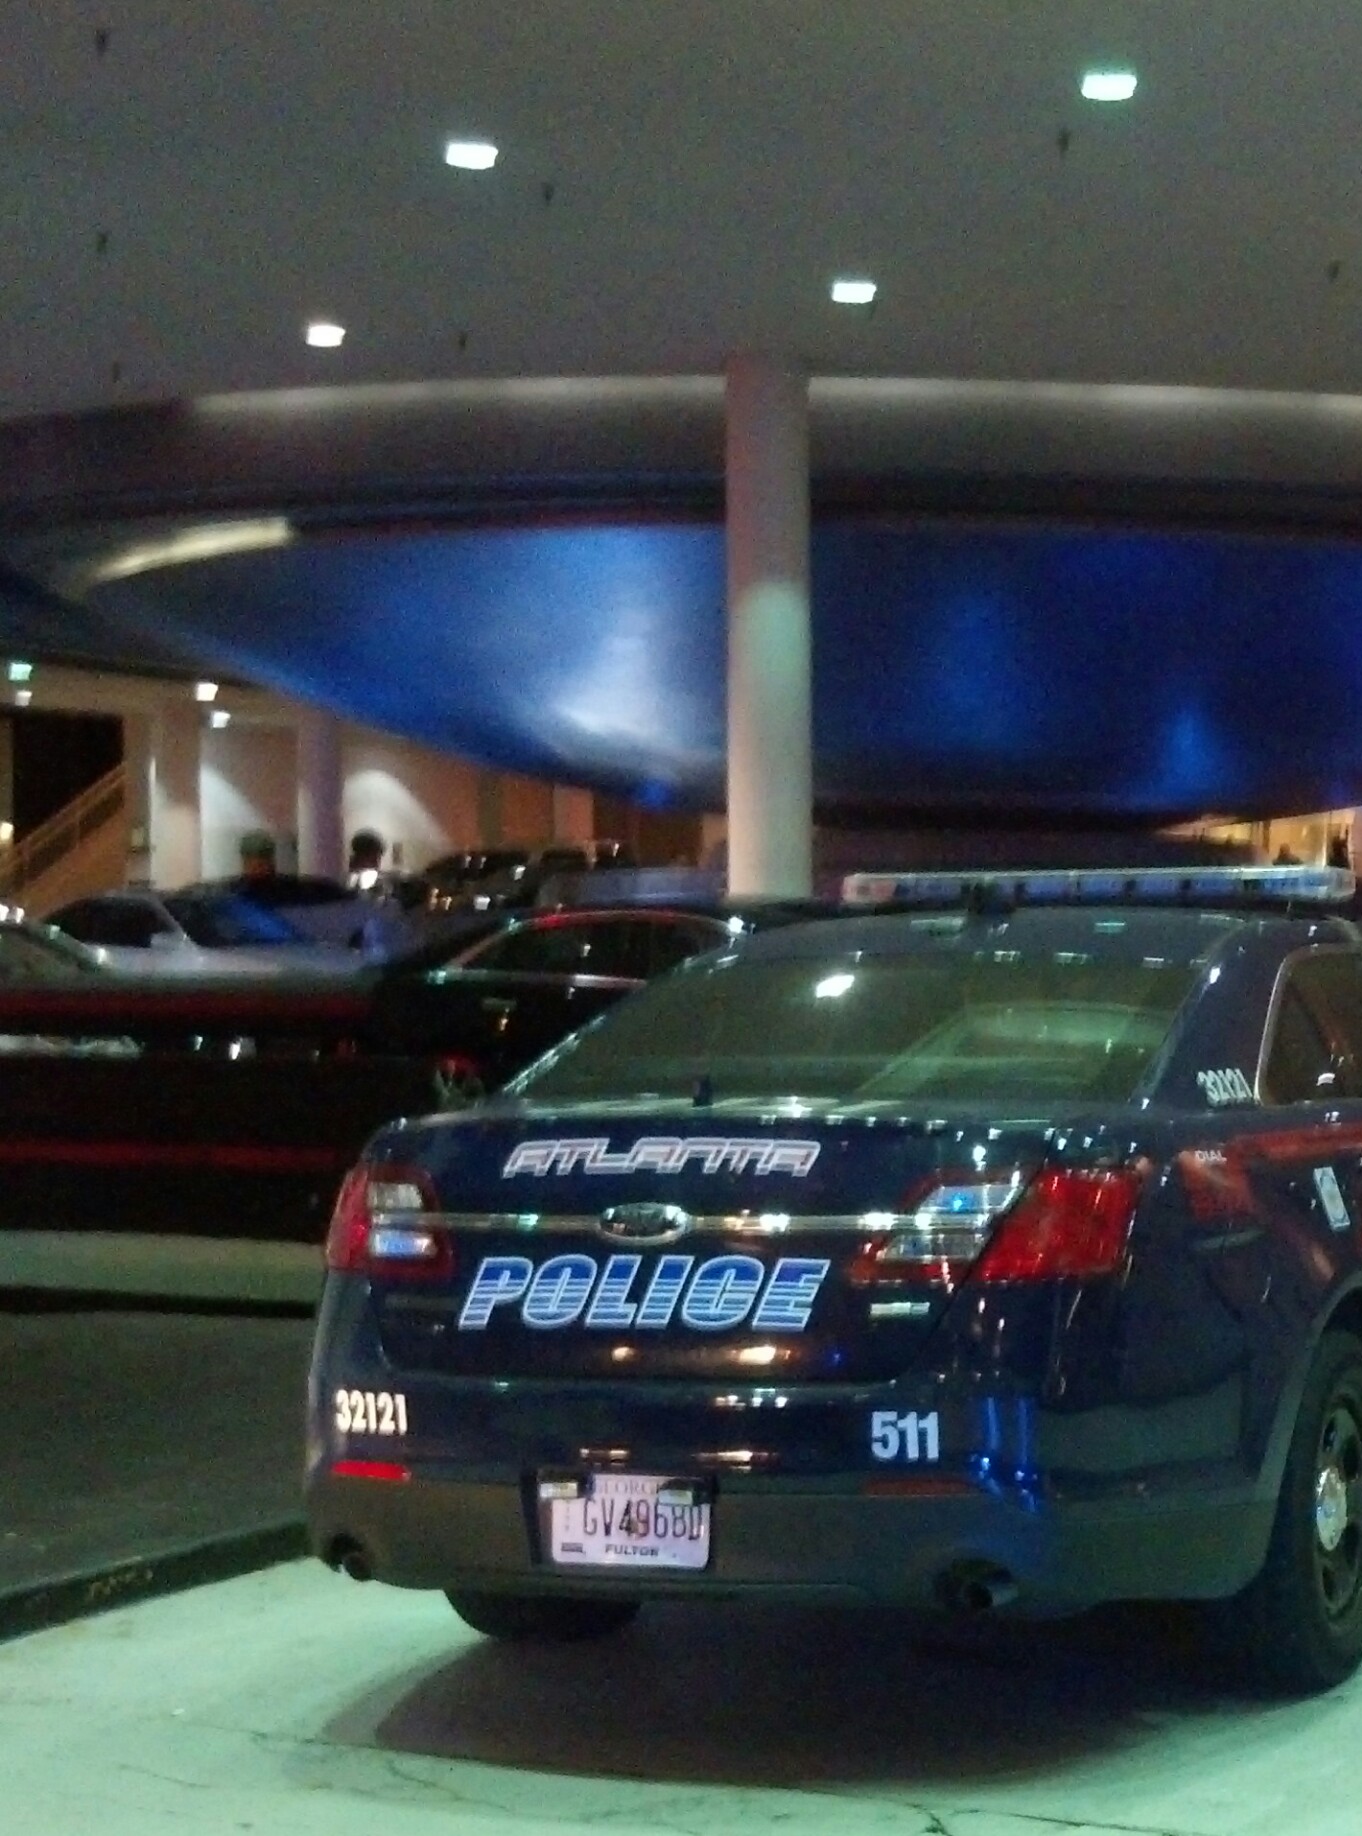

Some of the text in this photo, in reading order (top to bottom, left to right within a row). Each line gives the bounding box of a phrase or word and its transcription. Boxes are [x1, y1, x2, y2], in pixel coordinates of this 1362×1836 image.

[502, 1137, 822, 1178] ATLANTA
[458, 1254, 831, 1332] POLICE
[335, 1389, 408, 1435] 32121
[871, 1411, 940, 1461] 511
[605, 1544, 660, 1557] FULTON
